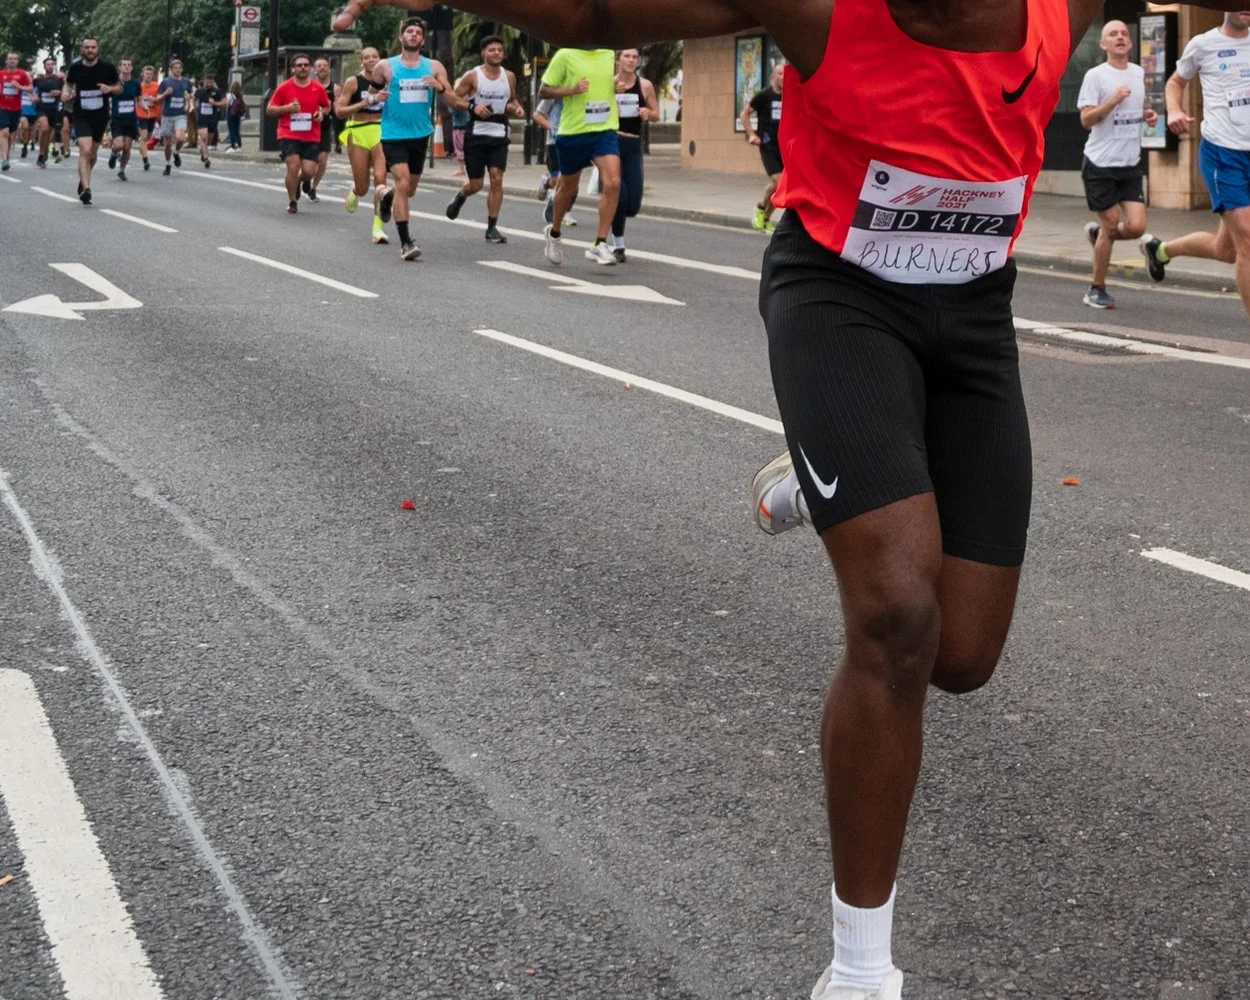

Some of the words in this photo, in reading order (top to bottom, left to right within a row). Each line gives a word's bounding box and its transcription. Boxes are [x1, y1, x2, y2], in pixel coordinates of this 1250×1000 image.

[942, 188, 1005, 198] HACKNEY
[939, 195, 975, 203] HALF
[936, 201, 967, 209] 2021
[897, 211, 919, 230] D
[930, 213, 1004, 234] 14172
